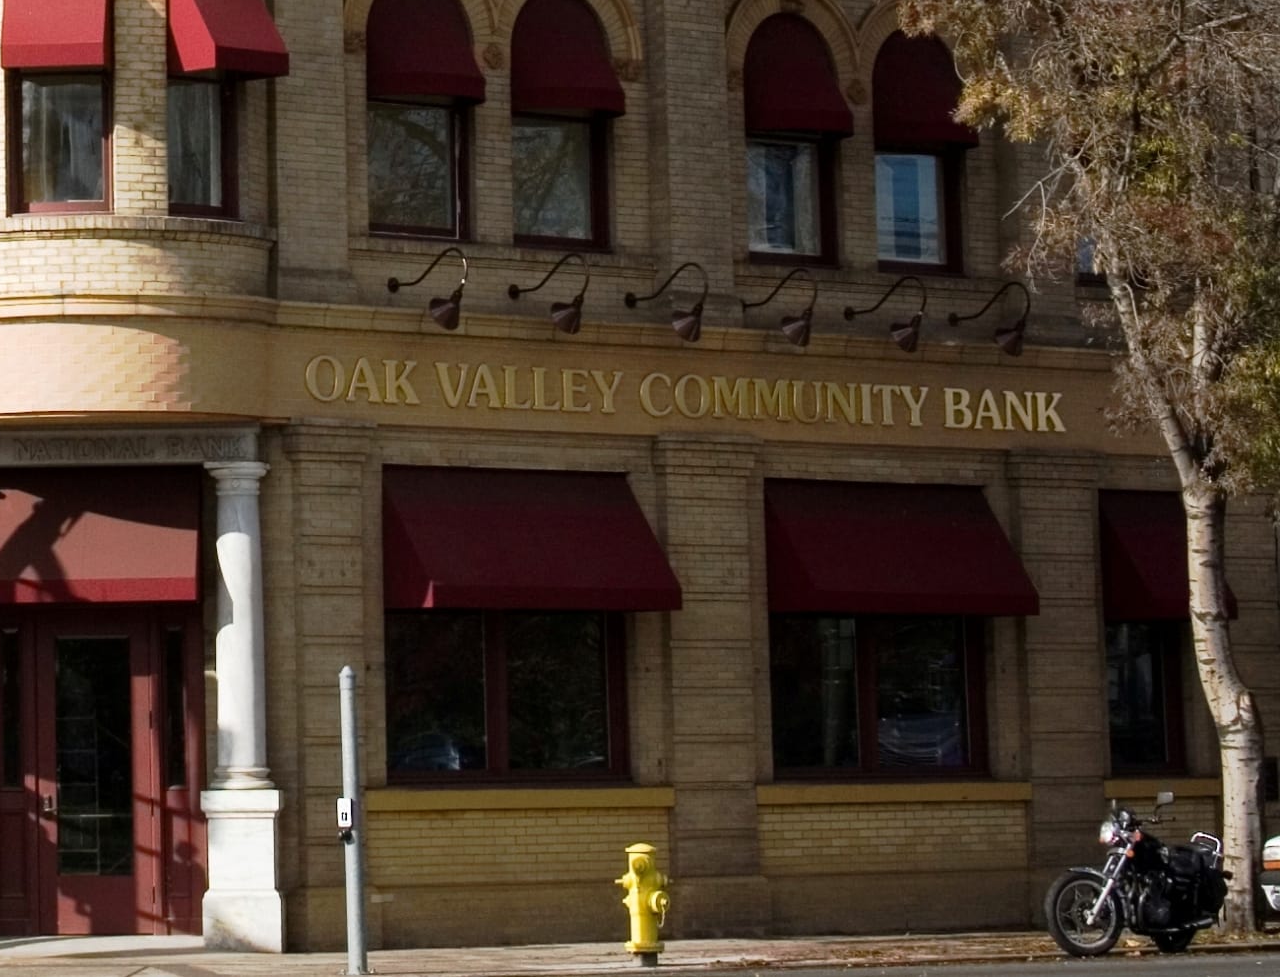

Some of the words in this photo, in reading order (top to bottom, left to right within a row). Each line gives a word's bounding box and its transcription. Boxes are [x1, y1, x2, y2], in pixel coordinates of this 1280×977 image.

[305, 355, 421, 404] OAK
[435, 362, 624, 414] VALLEY
[639, 373, 928, 427] COMMUNITY
[944, 387, 1067, 432] BANK
[15, 436, 155, 460] NATIONAL
[166, 437, 248, 459] BANK
